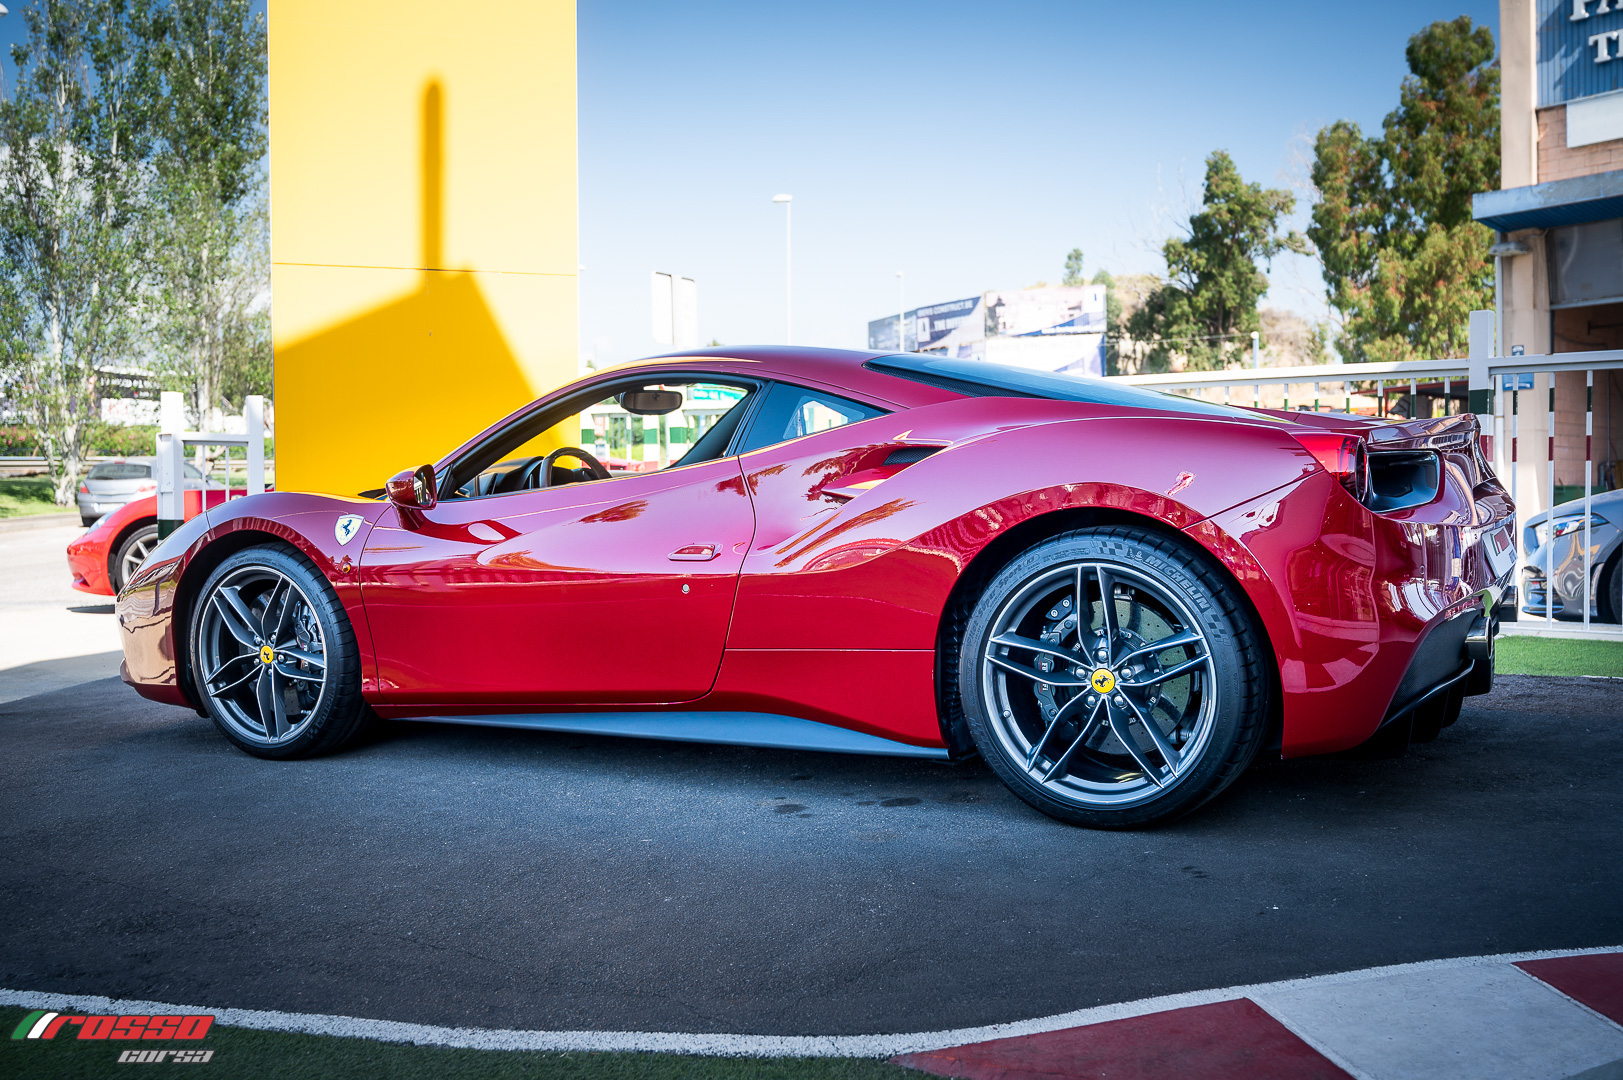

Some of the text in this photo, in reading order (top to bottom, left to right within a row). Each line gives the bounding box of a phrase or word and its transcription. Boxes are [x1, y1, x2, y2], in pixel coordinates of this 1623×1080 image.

[976, 587, 998, 618] Super
[996, 564, 1024, 589] Sport
[1146, 556, 1211, 610] MICHELIN
